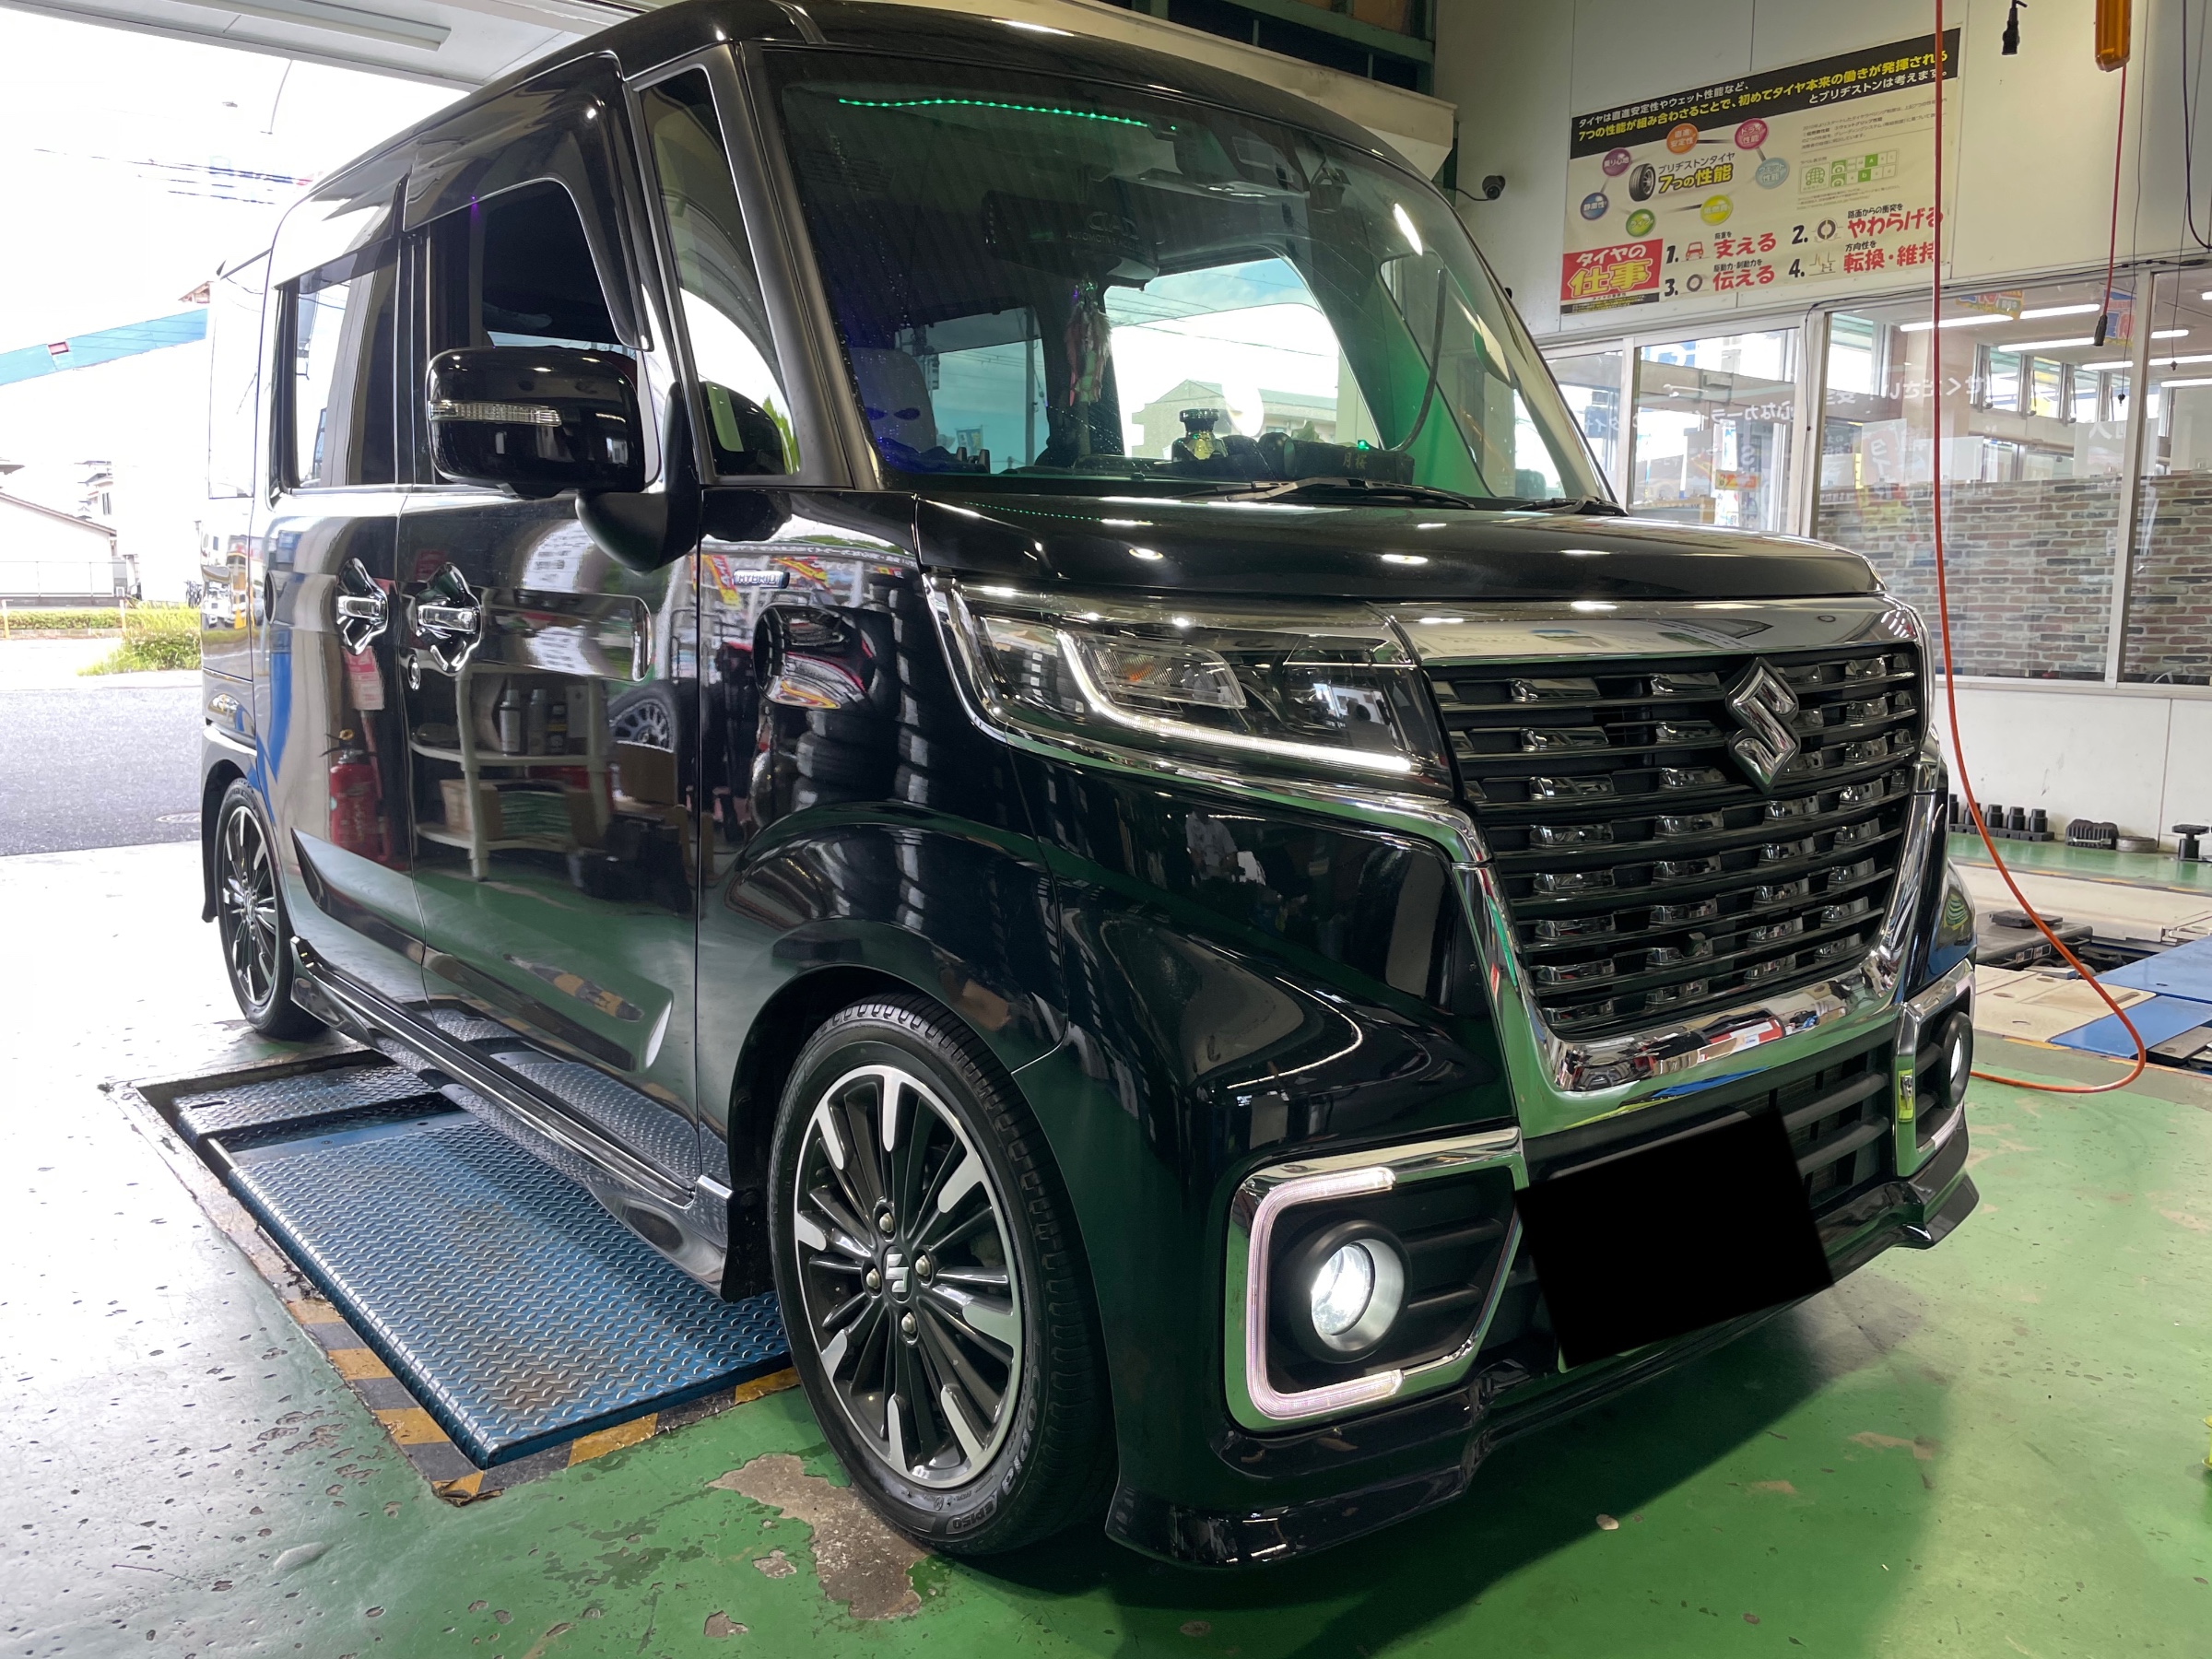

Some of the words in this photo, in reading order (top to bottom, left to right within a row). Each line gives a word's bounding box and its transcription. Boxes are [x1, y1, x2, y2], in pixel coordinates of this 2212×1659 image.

[1579, 81, 1749, 128] タイヤは直進安定性やウェット性能など、
[1741, 122, 1766, 135] ドライ
[1742, 132, 1759, 144] 性能
[1671, 136, 1693, 147] 安定性
[1603, 156, 1630, 169] 乗り心地
[1658, 151, 1735, 173] ブリヂストンタイヤ
[1658, 163, 1734, 194] 7つの性能
[1847, 206, 1944, 239] やわらげる
[1791, 225, 1808, 245] 2.
[1576, 243, 1647, 266] タイヤの
[1665, 245, 1679, 265] 1.
[1713, 232, 1777, 260] 支える
[1844, 240, 1877, 253] 方向性を
[1843, 240, 1936, 274] 転換・維持
[1569, 260, 1651, 297] 仕事
[1712, 265, 1775, 292] 伝える
[1788, 258, 1806, 278] 4.
[1664, 278, 1678, 297] 3.
[737, 573, 778, 585] HYBRID
[952, 1498, 994, 1530] EP150
